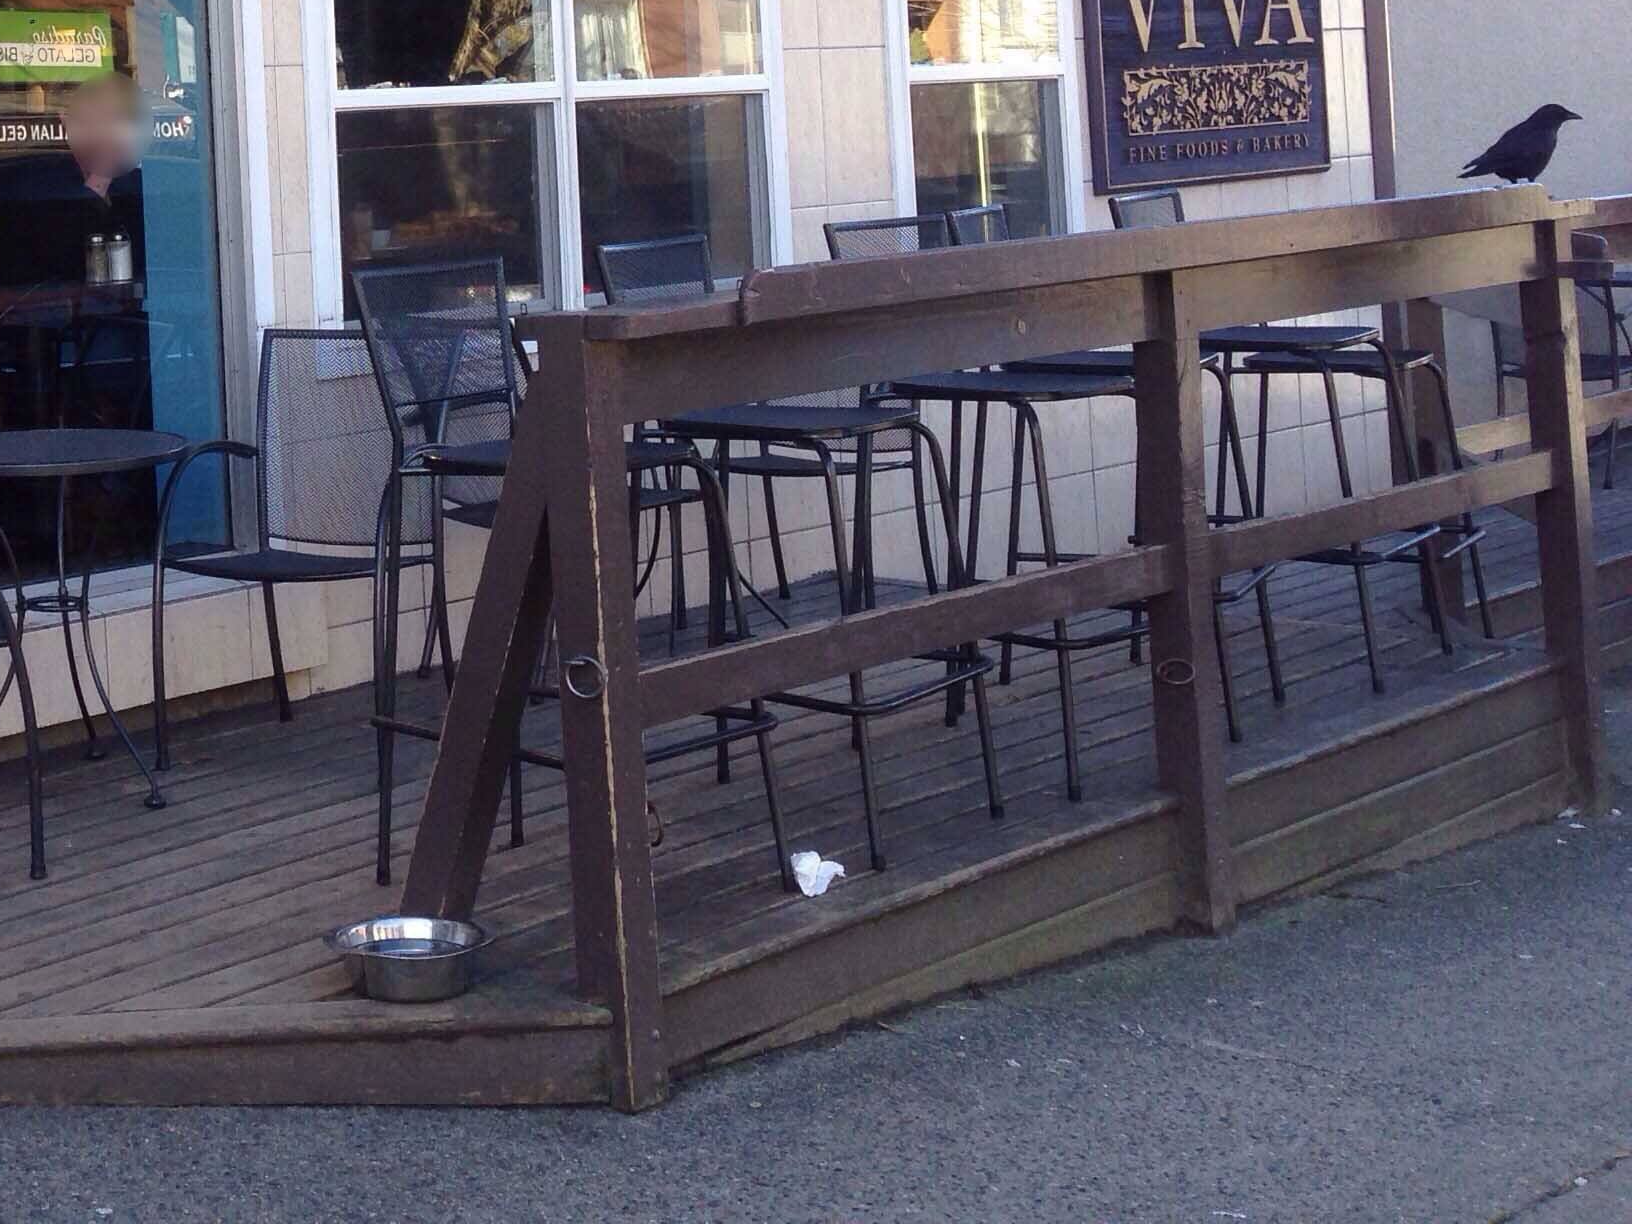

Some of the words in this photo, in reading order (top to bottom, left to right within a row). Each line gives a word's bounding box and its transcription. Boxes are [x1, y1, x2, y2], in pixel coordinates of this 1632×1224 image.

[1129, 143, 1168, 164] FINE
[1176, 138, 1229, 160] FOODS
[1252, 132, 1311, 153] BAKERY
